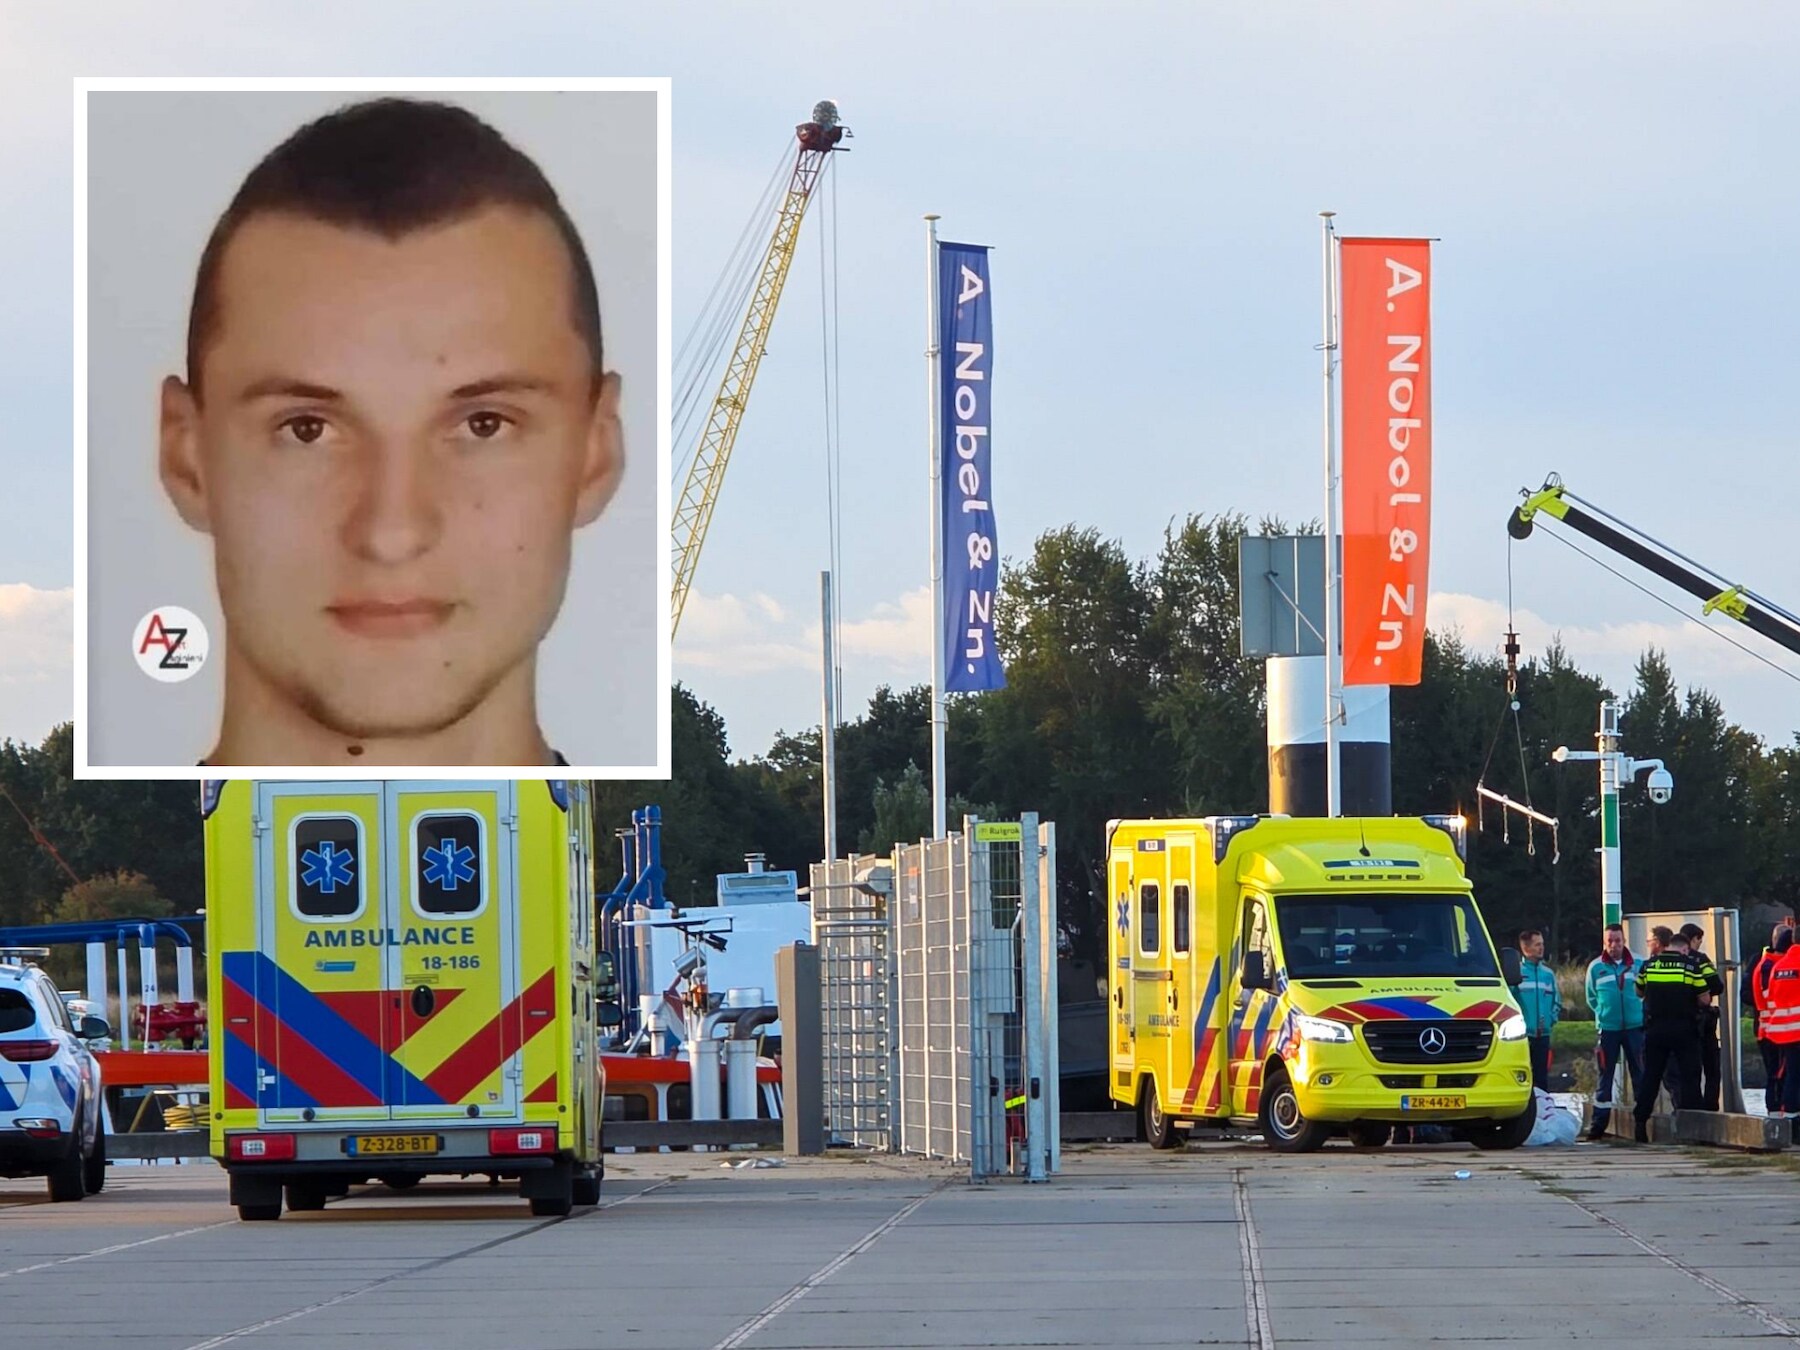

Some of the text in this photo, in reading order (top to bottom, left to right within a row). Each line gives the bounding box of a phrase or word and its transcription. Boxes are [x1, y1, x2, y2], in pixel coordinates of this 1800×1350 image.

[1385, 257, 1422, 312] A.
[955, 342, 989, 513] Nobel
[967, 532, 992, 570] &
[1389, 527, 1418, 562] &
[967, 590, 991, 675] Zn.
[1374, 583, 1415, 667] Zn.
[304, 927, 474, 948] AMBULANCE
[421, 956, 480, 970] 18-186
[1411, 1097, 1461, 1108] ZR-442-K
[362, 1136, 430, 1152] Z-328-BT
